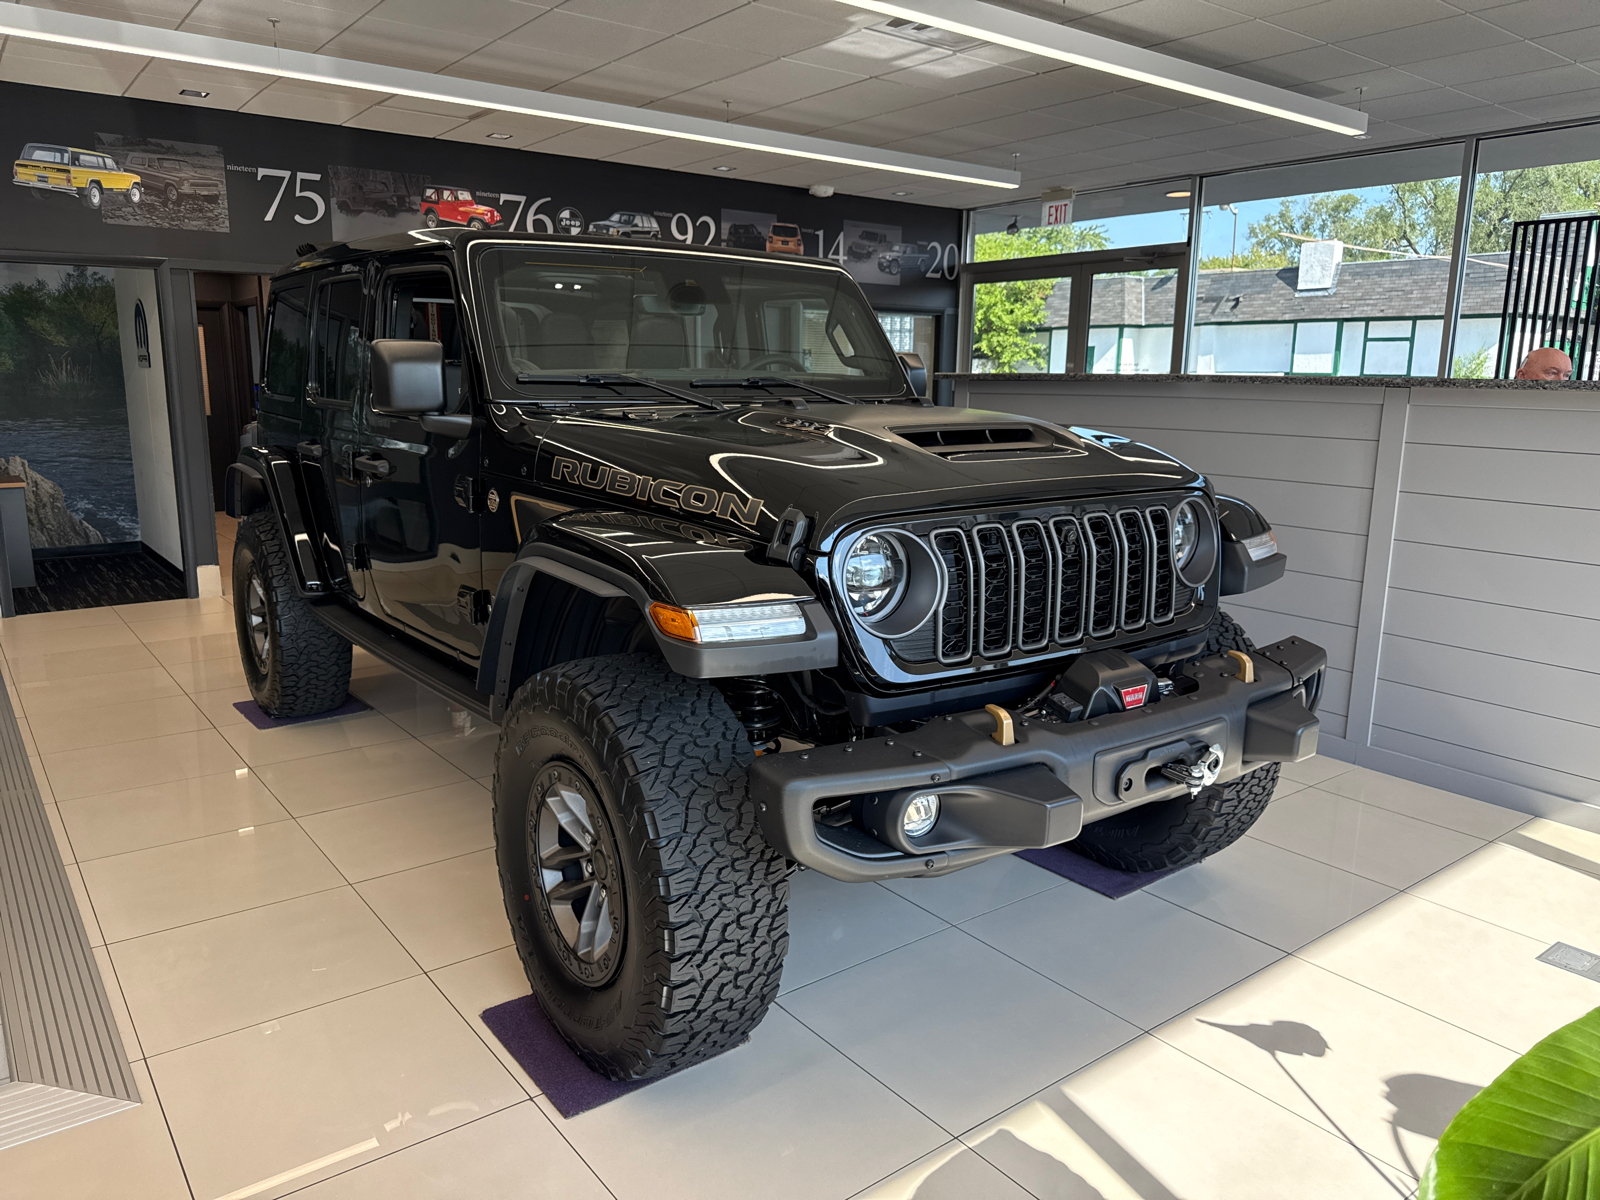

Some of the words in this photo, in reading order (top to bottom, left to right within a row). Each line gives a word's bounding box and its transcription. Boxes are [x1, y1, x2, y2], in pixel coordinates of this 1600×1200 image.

[227, 163, 257, 173] nineteen
[257, 167, 326, 225] 75
[476, 190, 499, 199] nineteen
[500, 193, 554, 234] 76
[560, 218, 581, 227] Jeep
[671, 212, 716, 246] 92
[1048, 203, 1069, 225] EXIT
[815, 229, 848, 265] 14
[925, 241, 959, 281] 20
[551, 456, 764, 525] RUBICON
[1125, 692, 1143, 702] WARN
